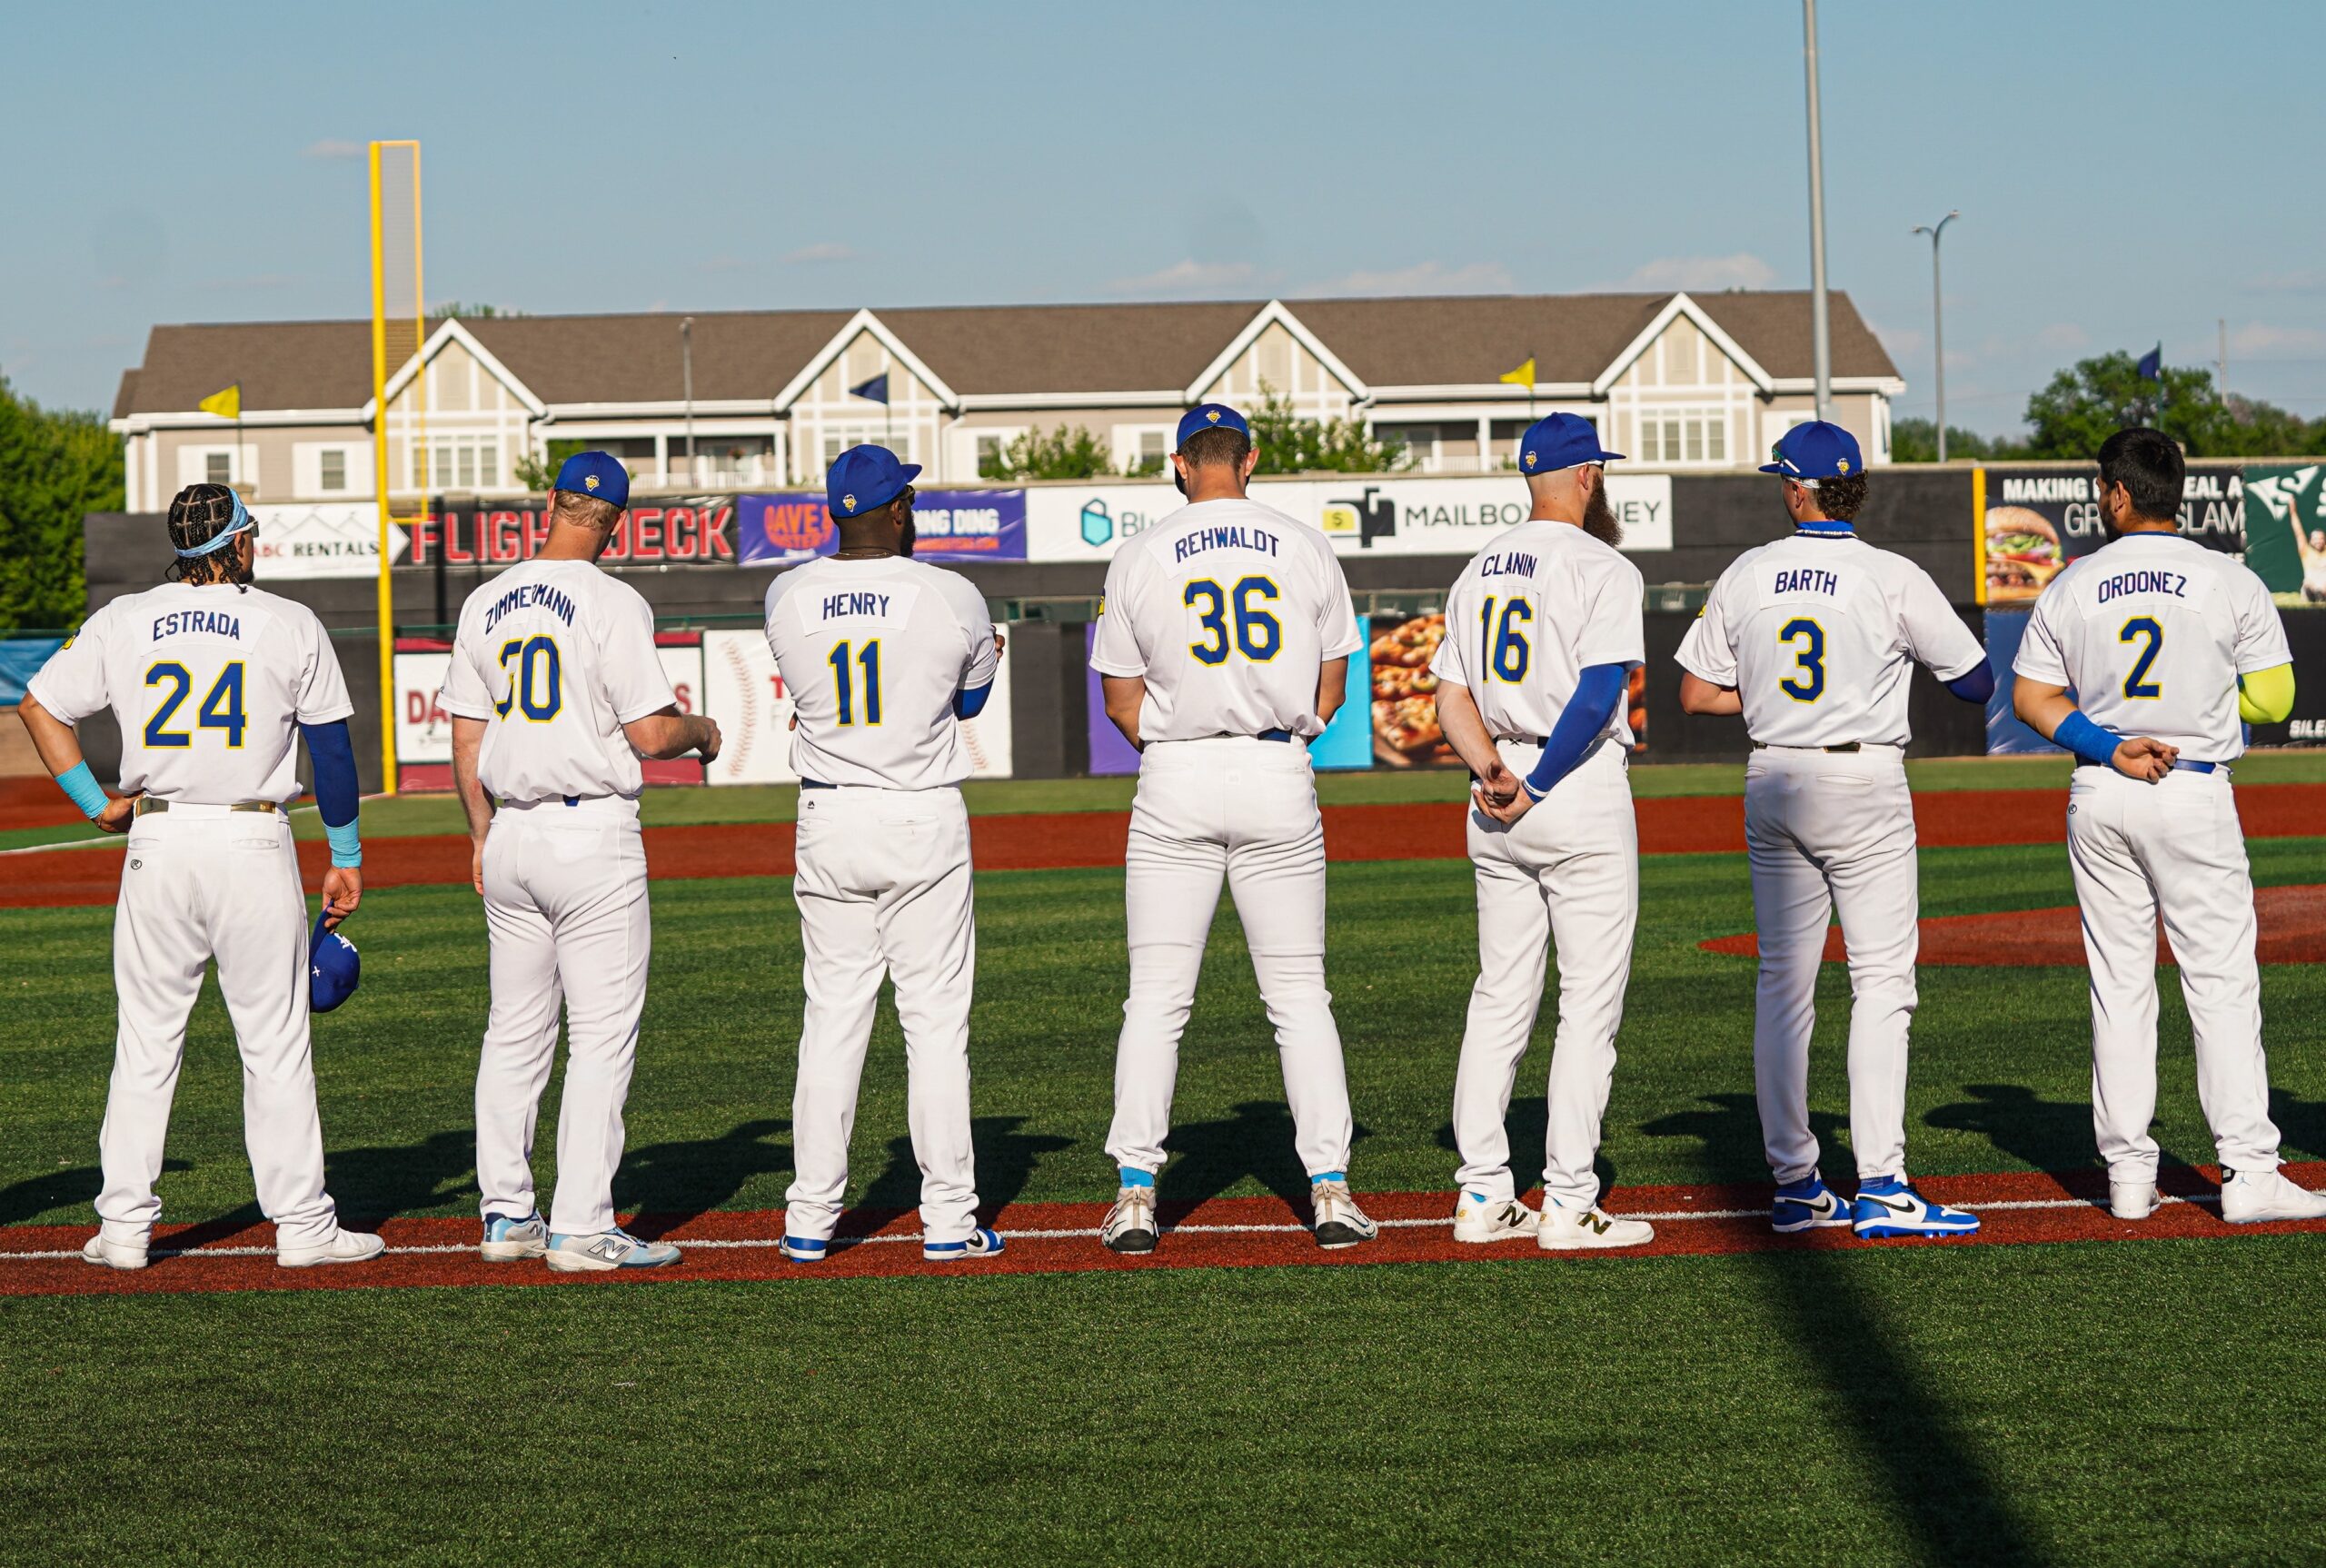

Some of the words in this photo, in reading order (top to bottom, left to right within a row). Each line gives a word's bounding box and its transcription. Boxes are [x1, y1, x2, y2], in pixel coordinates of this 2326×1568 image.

[2003, 478, 2089, 502] MAKING
[2182, 475, 2223, 500] EAL
[411, 510, 550, 565] FLIGH
[912, 509, 951, 536] ING
[953, 508, 999, 536] DING
[293, 541, 380, 557] RENTALS
[1175, 526, 1279, 564] REHWALDT
[1481, 551, 1537, 579] CLANIN
[1774, 569, 1837, 596] BARTH
[2098, 571, 2187, 603] ORDONEZ
[822, 592, 890, 620] HENRY
[1182, 574, 1284, 668] 36
[153, 610, 240, 641] ESTRADA
[1479, 595, 1534, 684] 16
[1778, 616, 1827, 704] 3
[2118, 615, 2164, 700] 2
[827, 639, 883, 727] 11
[143, 660, 249, 749] 24
[2290, 719, 2326, 739] SILE
